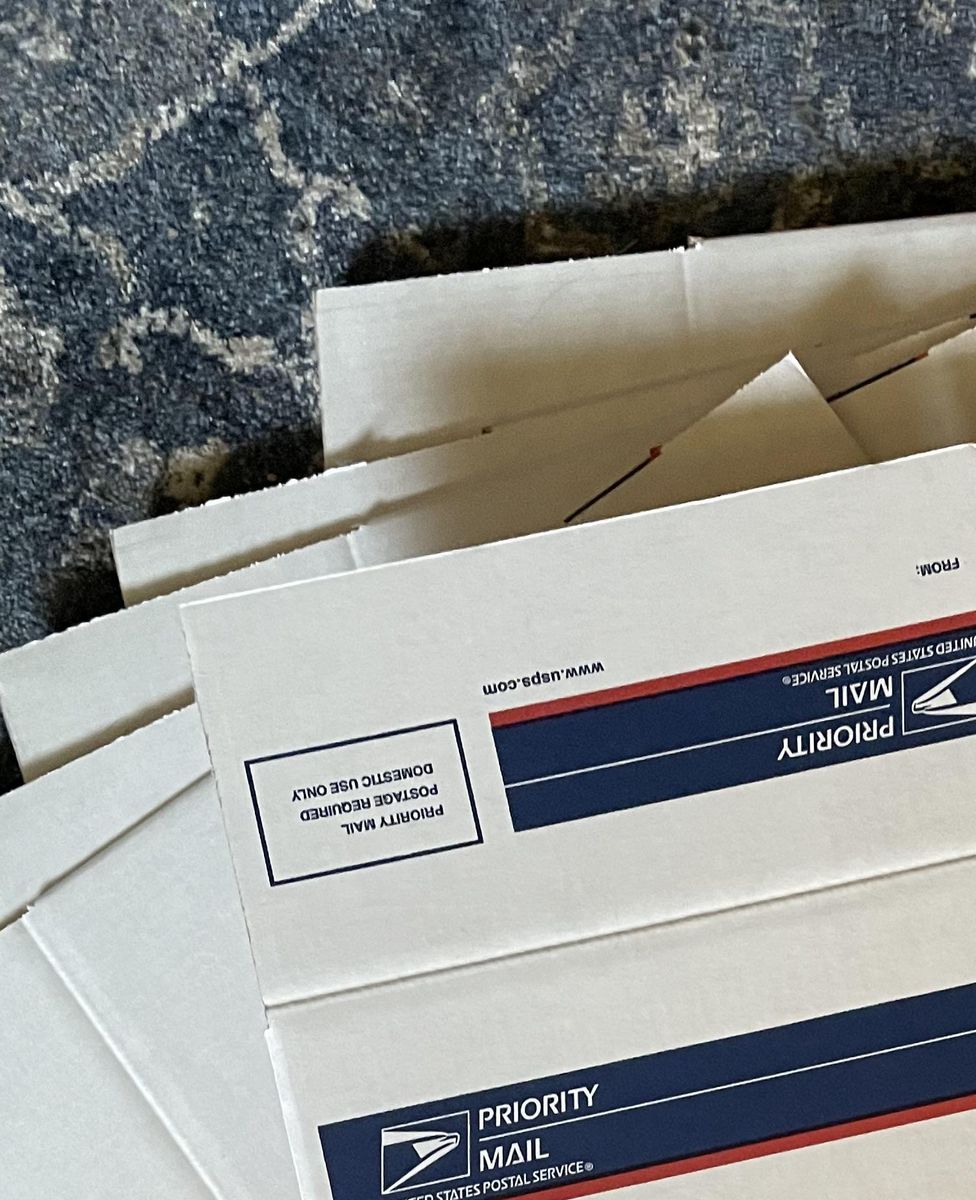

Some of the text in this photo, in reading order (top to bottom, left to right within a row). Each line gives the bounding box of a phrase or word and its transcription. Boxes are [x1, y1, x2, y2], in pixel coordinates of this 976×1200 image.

[916, 557, 960, 577] FROM:
[843, 653, 890, 673] POSTAL
[891, 643, 935, 664] STATES
[482, 662, 604, 696] www.usps.com
[826, 676, 894, 708] MAIL
[776, 715, 895, 761] PRIORITY
[291, 763, 433, 802] DOMESTIC USE ONLY
[300, 784, 438, 821] POSTAGE REQUIRED
[341, 804, 444, 835] PRIORITY MAIL
[479, 1084, 599, 1130] PRIORITY
[479, 1138, 549, 1172] MAIL
[483, 1174, 530, 1193] POSTAL
